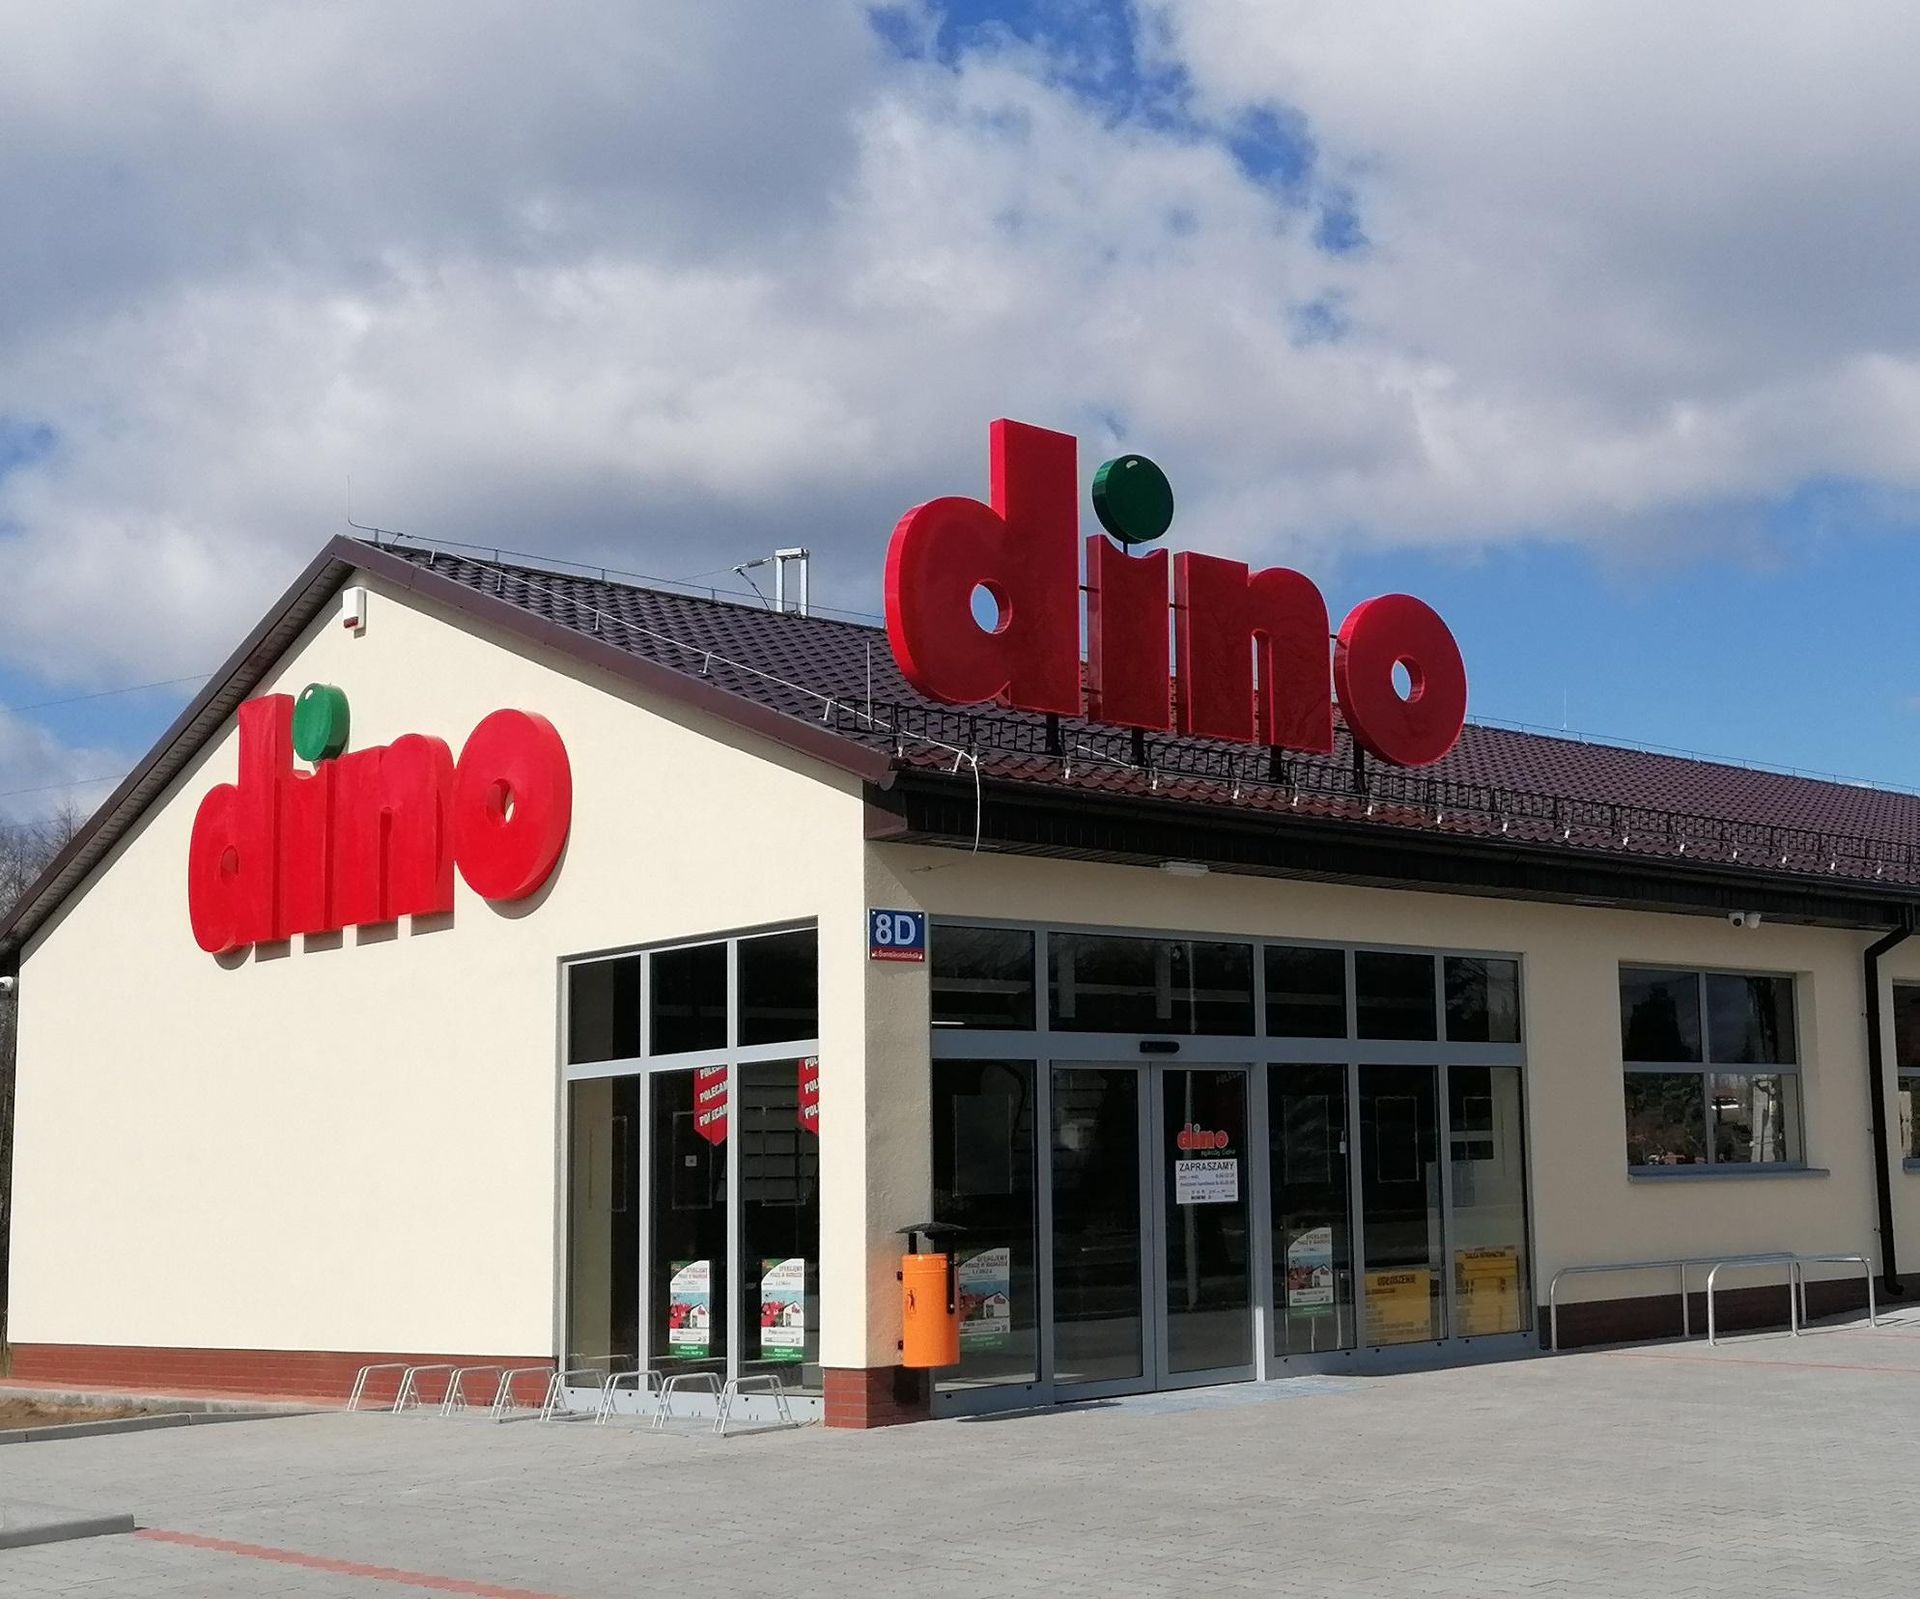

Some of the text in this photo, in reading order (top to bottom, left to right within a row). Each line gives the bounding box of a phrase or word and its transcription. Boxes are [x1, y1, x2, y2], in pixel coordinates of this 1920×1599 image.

[884, 418, 1468, 766] dino
[188, 683, 573, 953] dino
[875, 913, 916, 945] 8D
[1177, 1122, 1229, 1150] dino
[1179, 1161, 1235, 1172] ZAPRASZAMY
